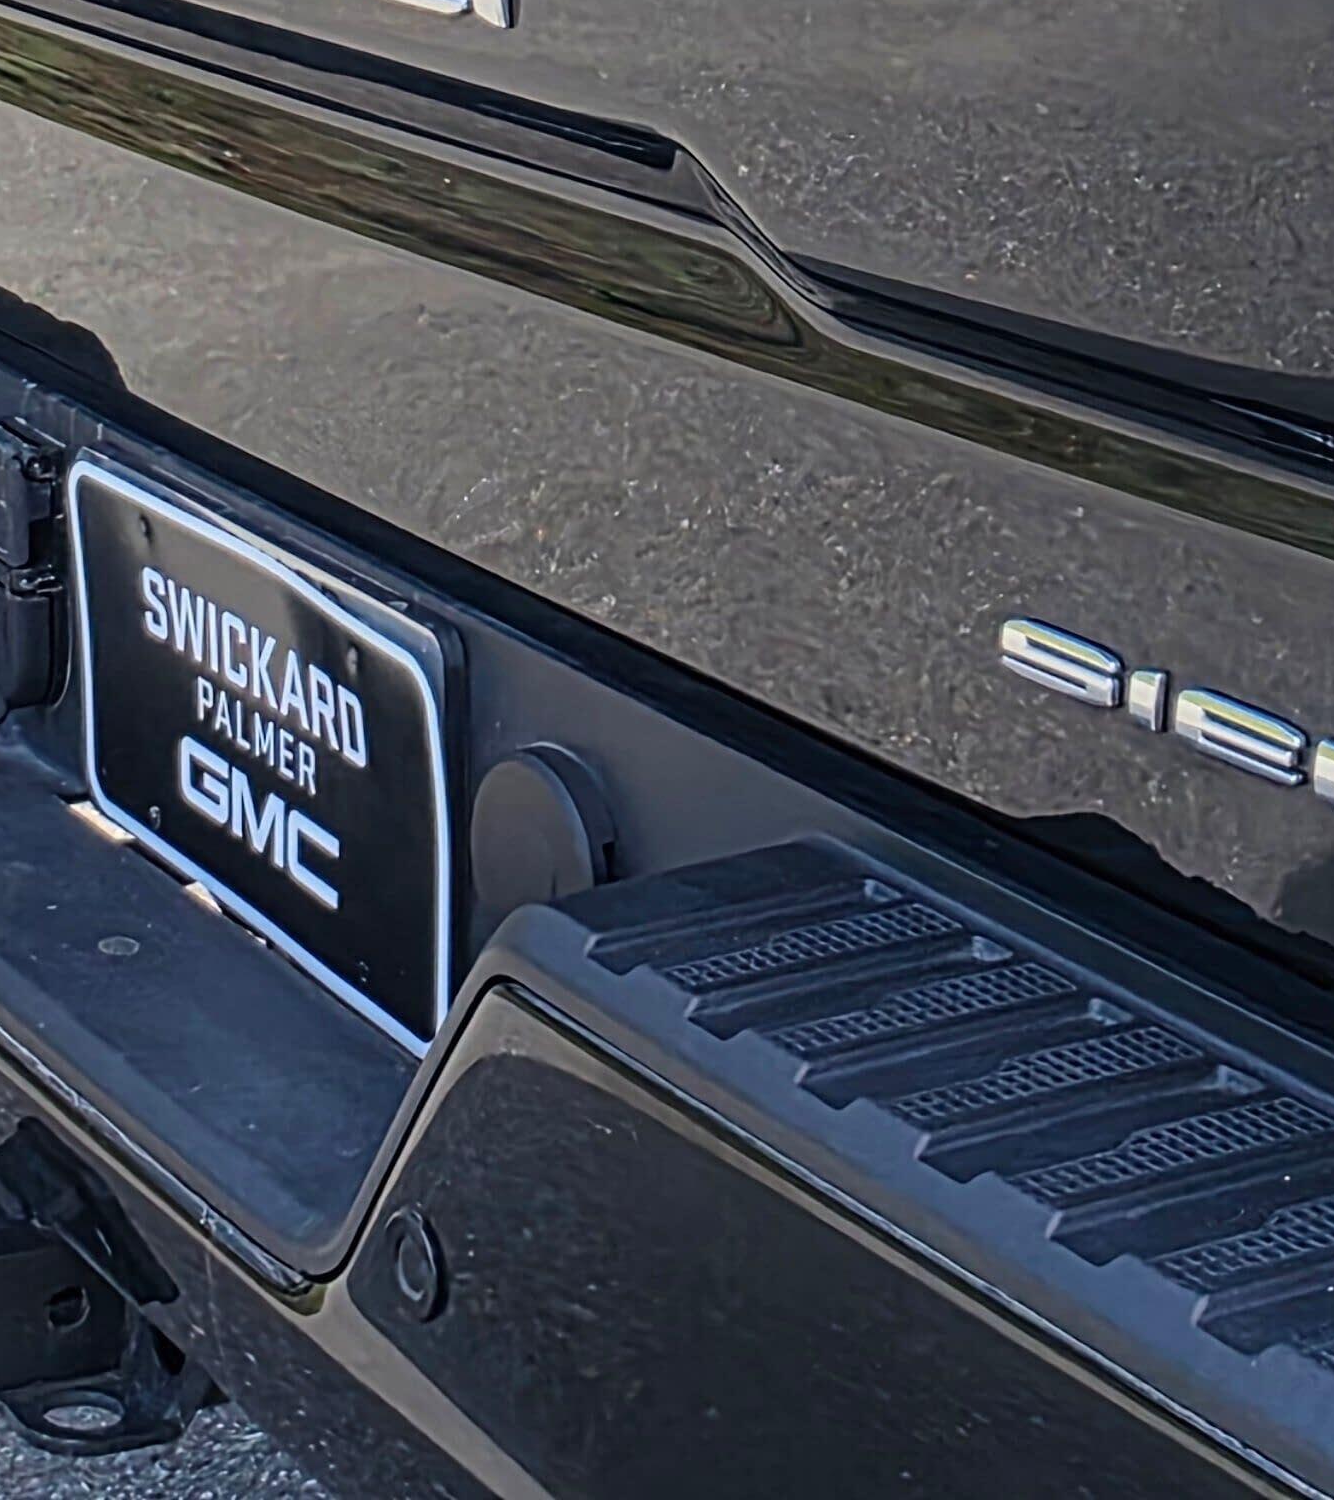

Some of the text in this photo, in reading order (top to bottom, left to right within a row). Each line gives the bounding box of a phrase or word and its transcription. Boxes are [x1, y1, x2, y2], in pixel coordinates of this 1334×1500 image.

[142, 566, 368, 769] SWICKARD
[196, 676, 317, 796] PALMER
[181, 735, 341, 910] GMC
